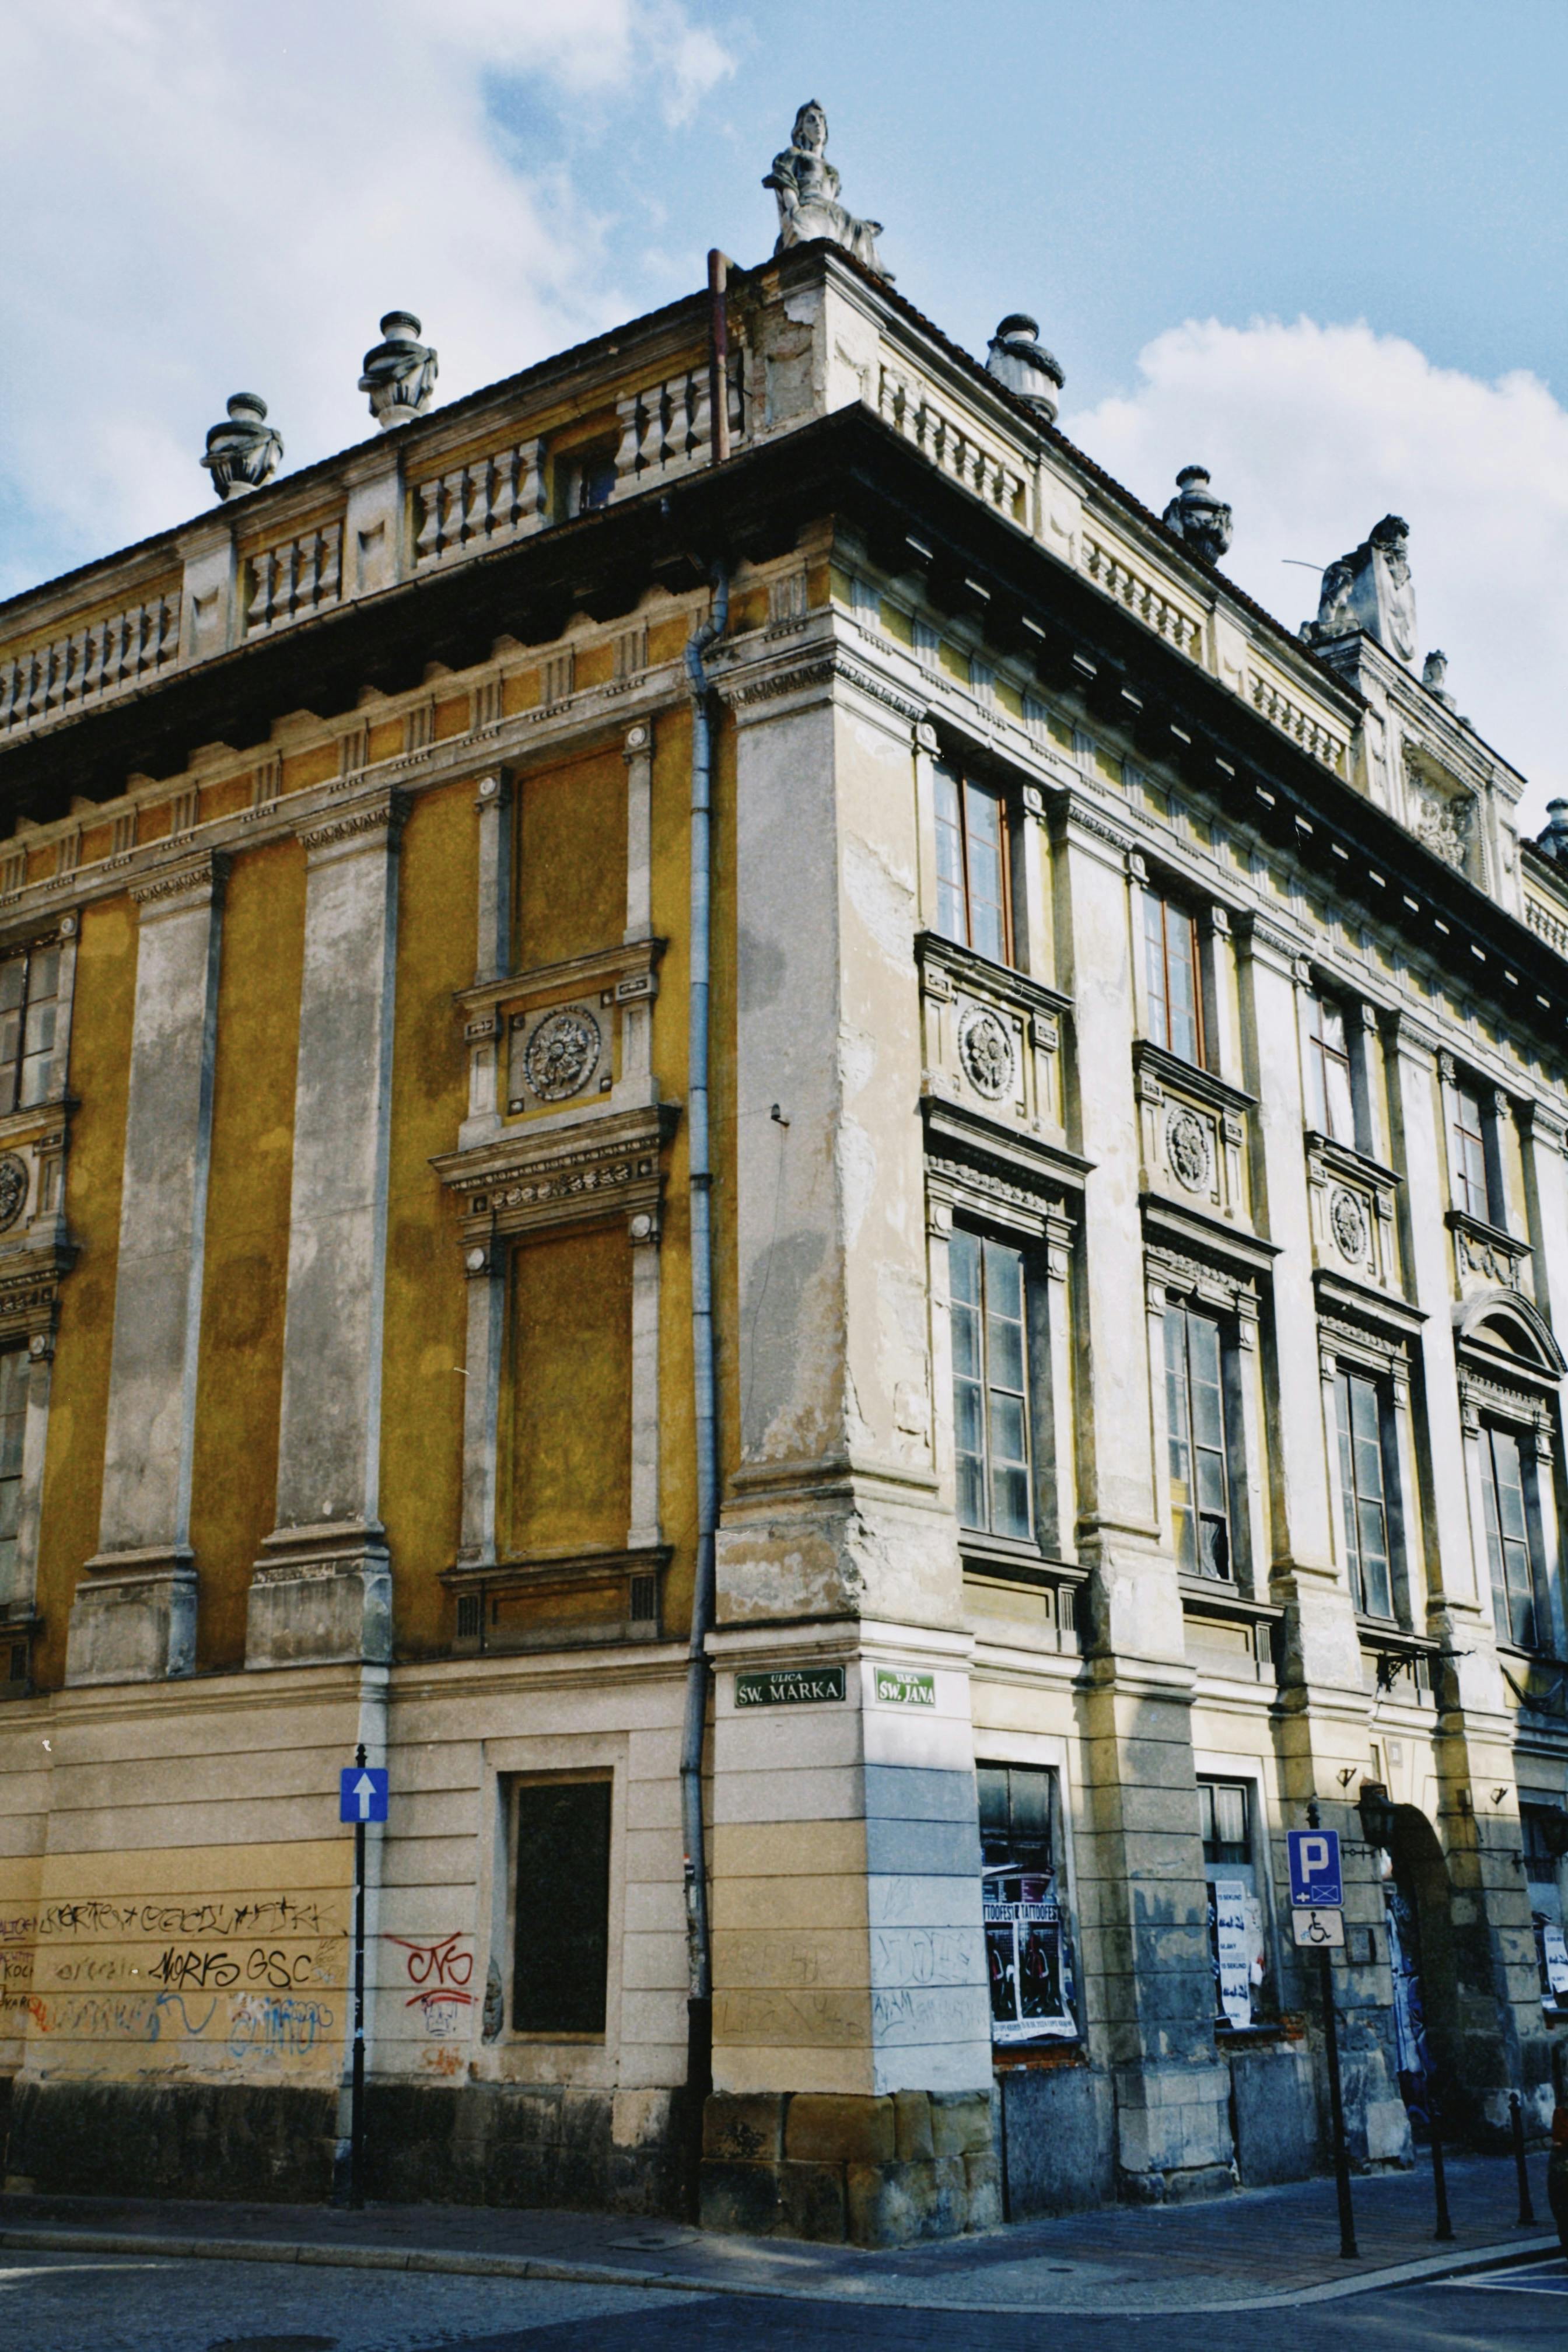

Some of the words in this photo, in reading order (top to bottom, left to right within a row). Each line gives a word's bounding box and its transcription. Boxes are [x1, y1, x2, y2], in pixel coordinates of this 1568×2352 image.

[771, 1673, 803, 1683] ULICA
[896, 1673, 919, 1684] ULICA
[738, 1685, 762, 1704] ŚW.
[769, 1681, 839, 1700] MARKA
[879, 1681, 902, 1700] ŚW.
[903, 1684, 935, 1703] JANA
[1299, 1836, 1329, 1883] P
